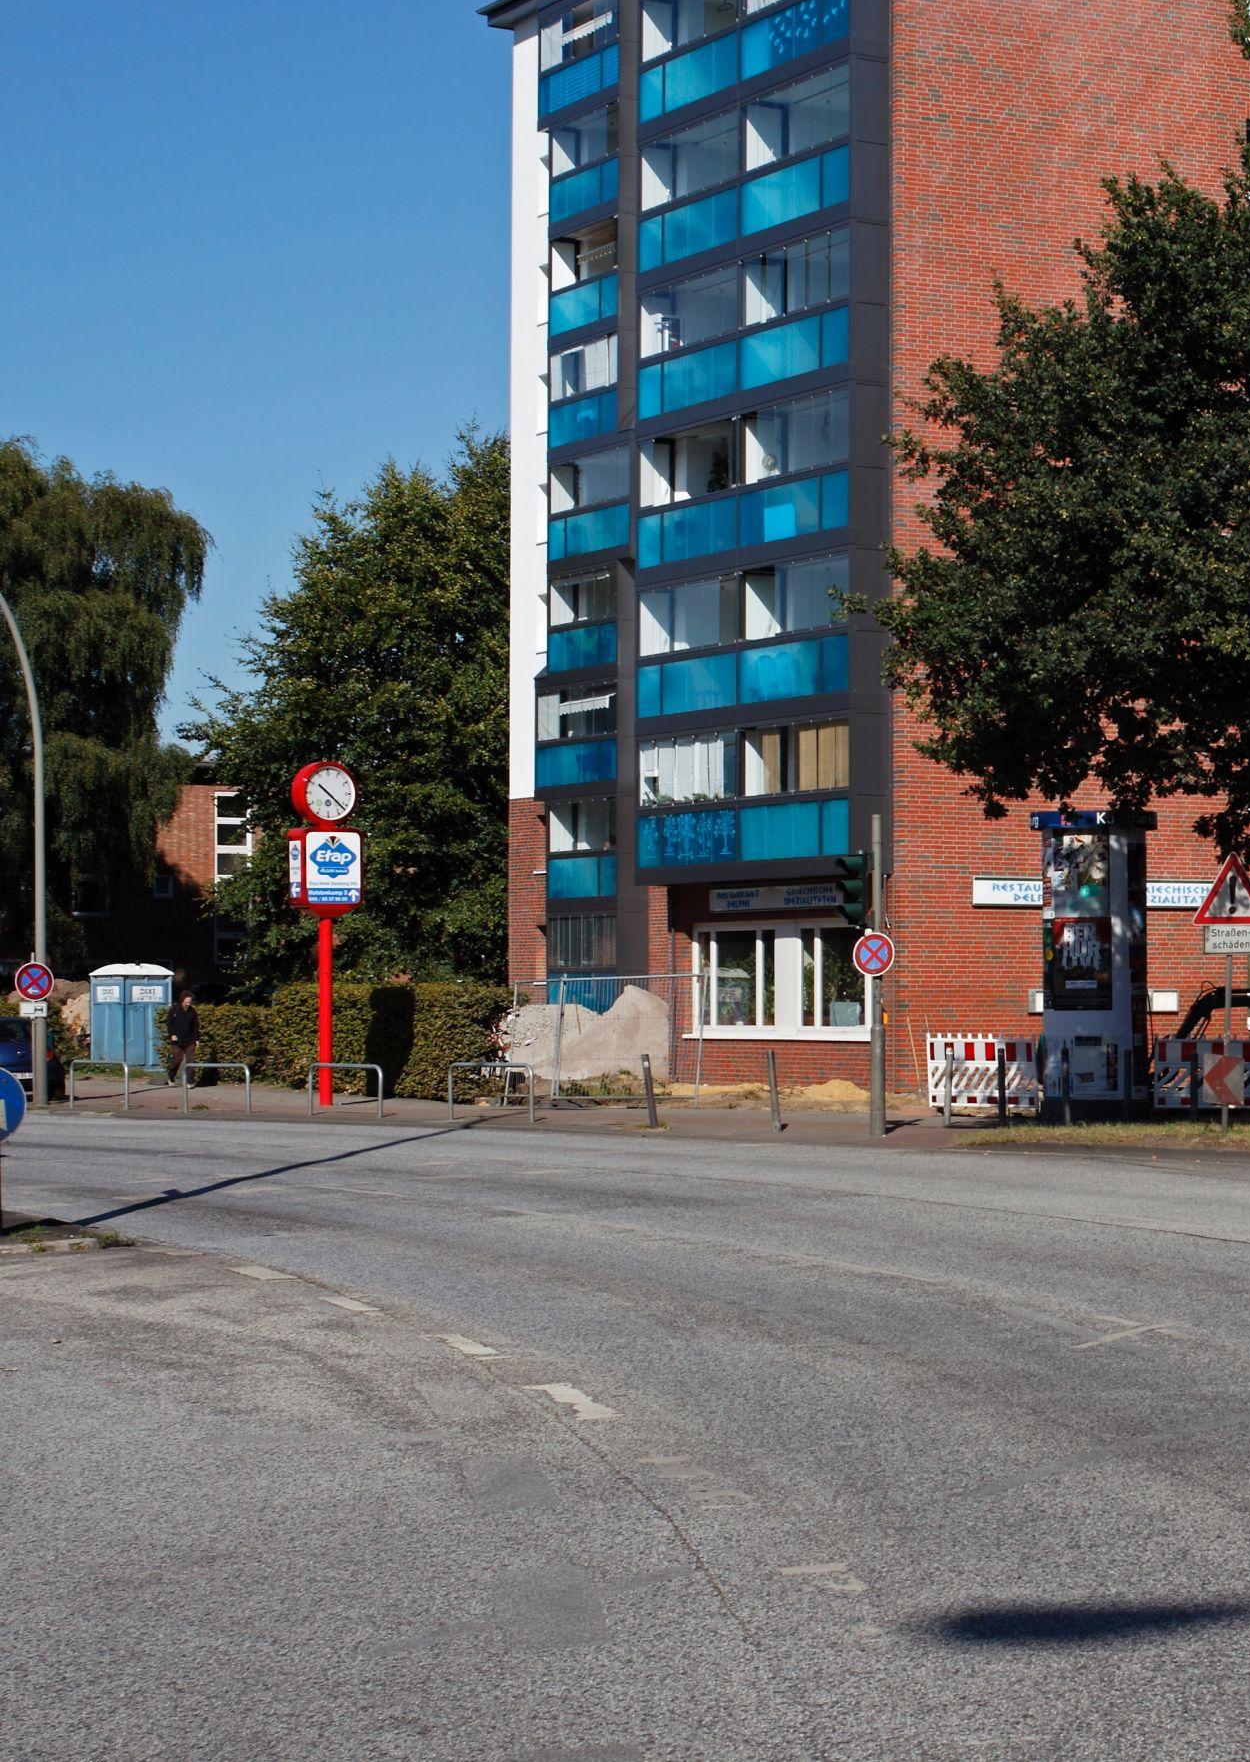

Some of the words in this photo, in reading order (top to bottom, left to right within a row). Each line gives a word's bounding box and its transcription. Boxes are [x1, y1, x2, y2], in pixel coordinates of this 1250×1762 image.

[316, 849, 352, 865] Etap
[991, 883, 1041, 892] RESTAU
[1147, 885, 1210, 894] IECHISCH
[1212, 939, 1250, 949] schäden
